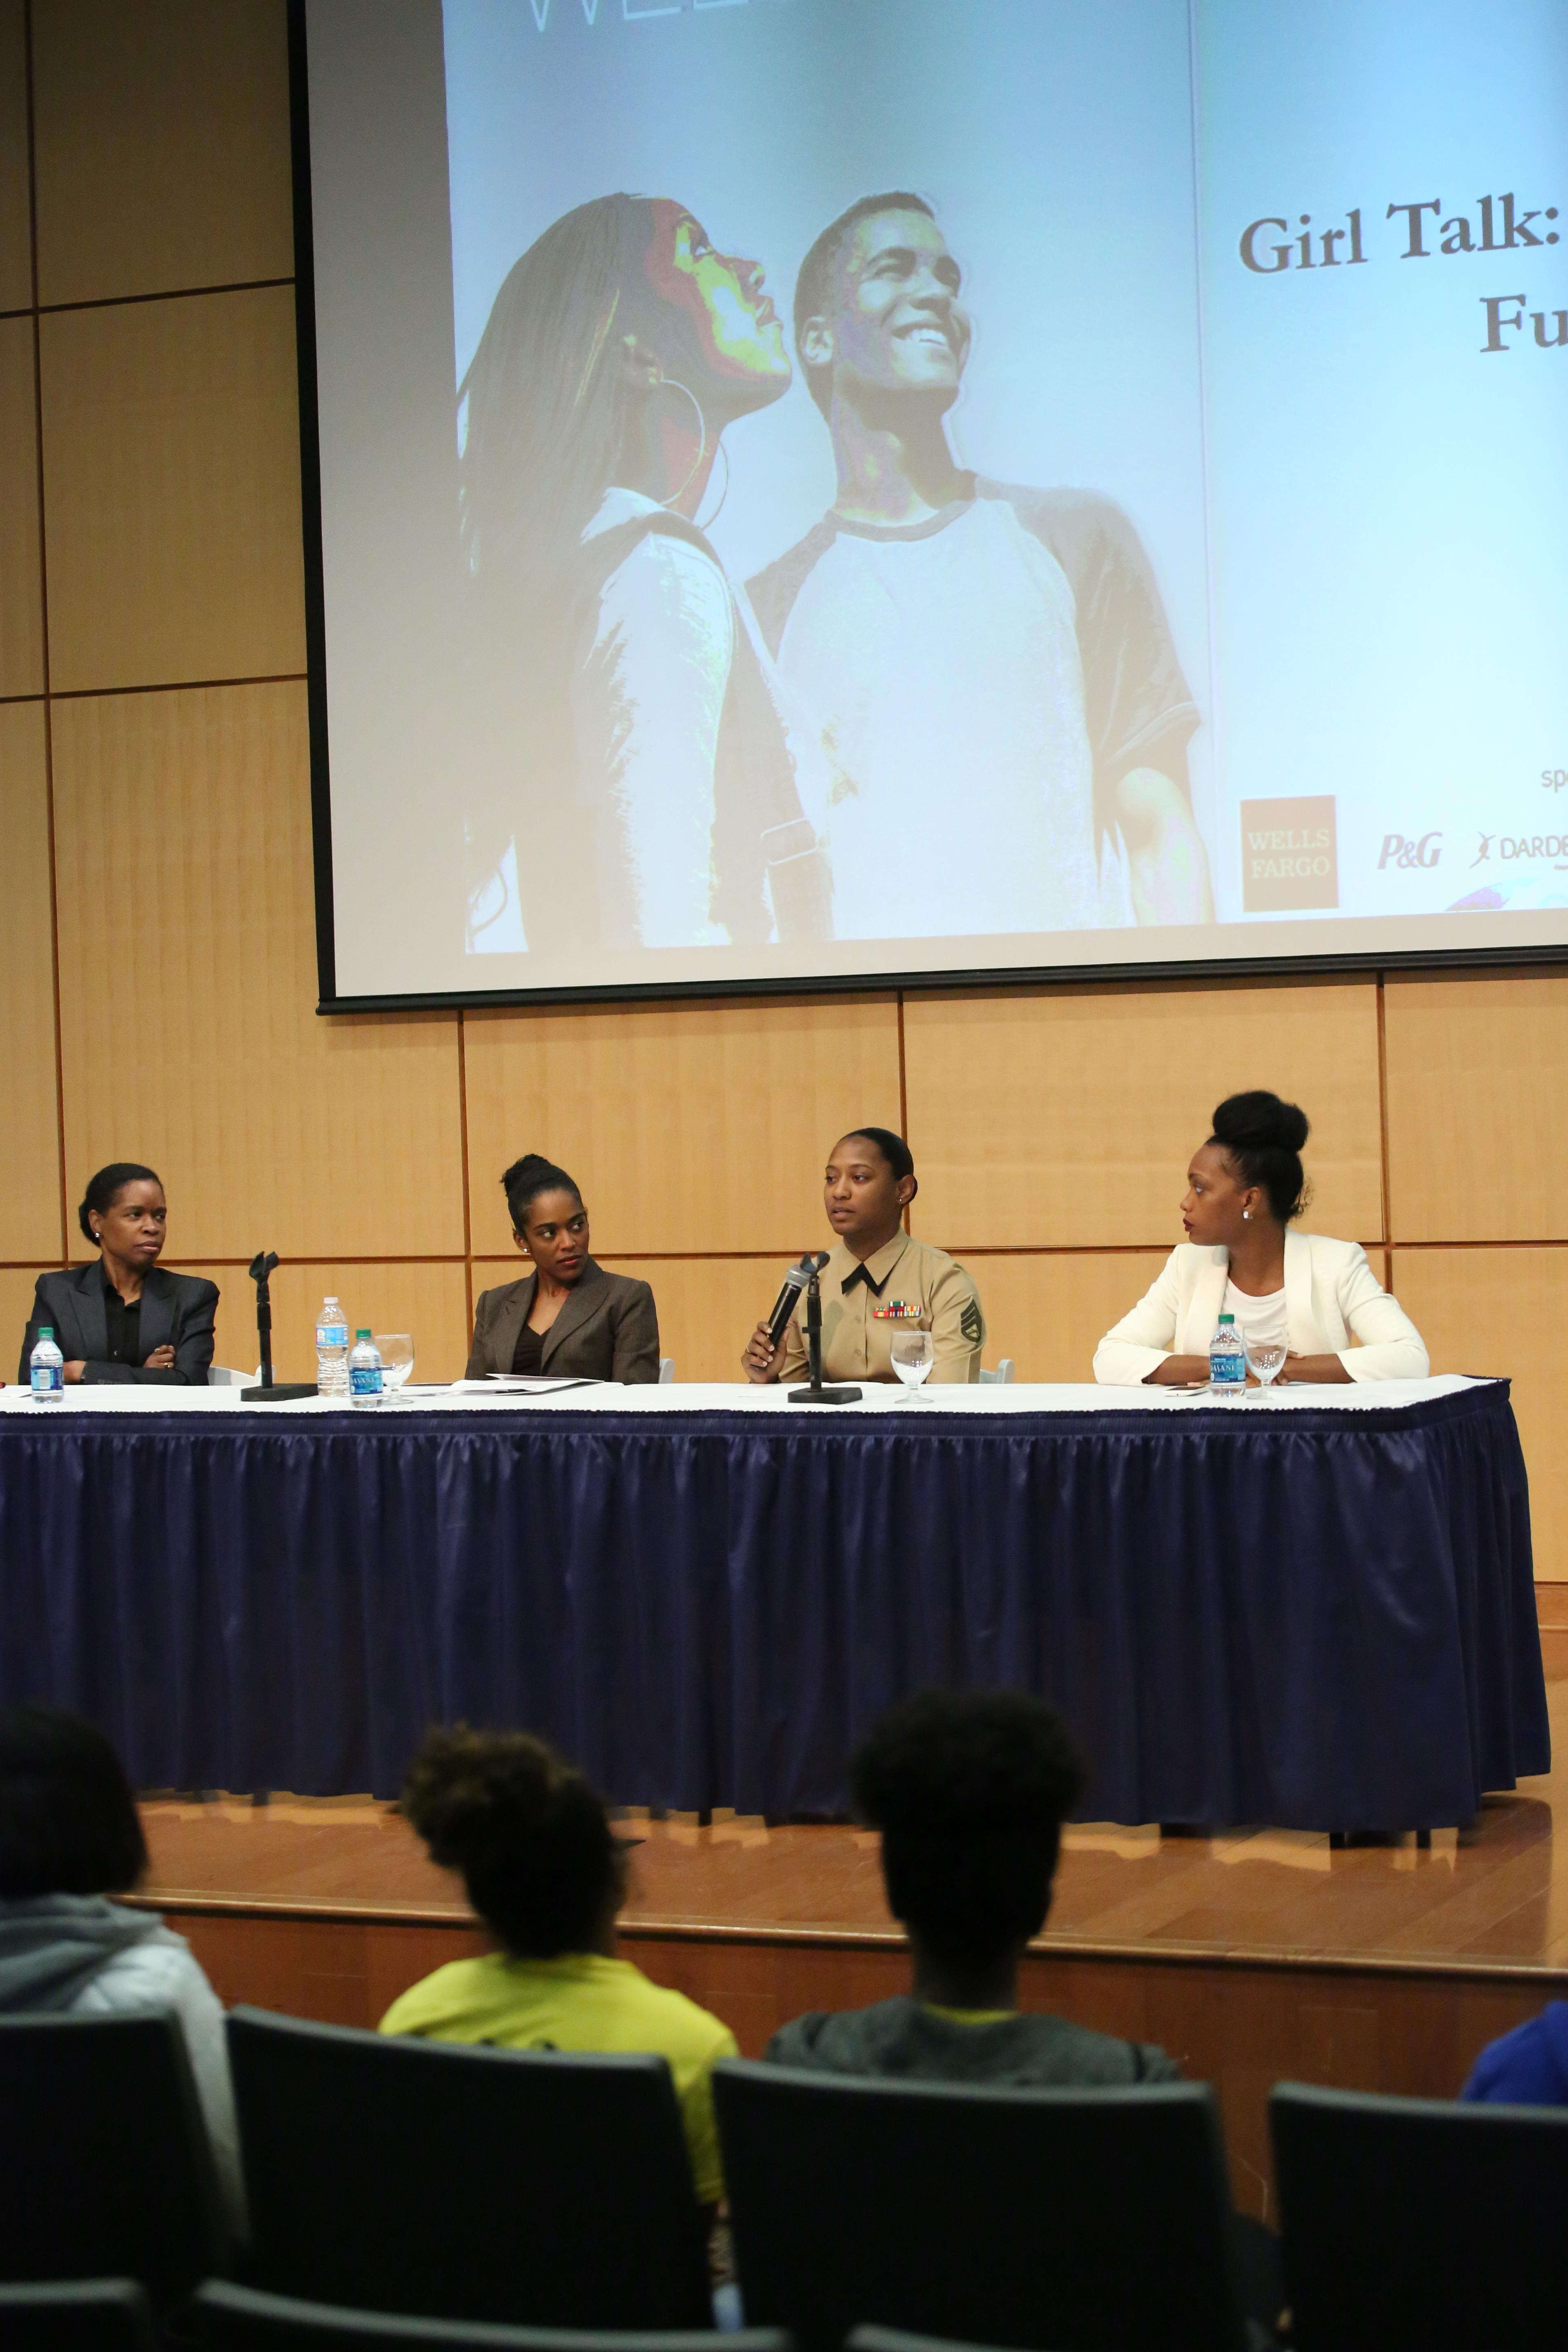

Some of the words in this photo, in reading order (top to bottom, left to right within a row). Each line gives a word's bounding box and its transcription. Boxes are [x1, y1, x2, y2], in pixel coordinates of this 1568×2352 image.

[1239, 208, 1368, 274] Girl
[1386, 192, 1559, 258] Talk:
[1479, 294, 1568, 353] Fu
[1541, 769, 1568, 793] sp
[1247, 829, 1330, 851] WELLS
[1377, 832, 1443, 870] P&G
[1251, 856, 1330, 879] FARGO
